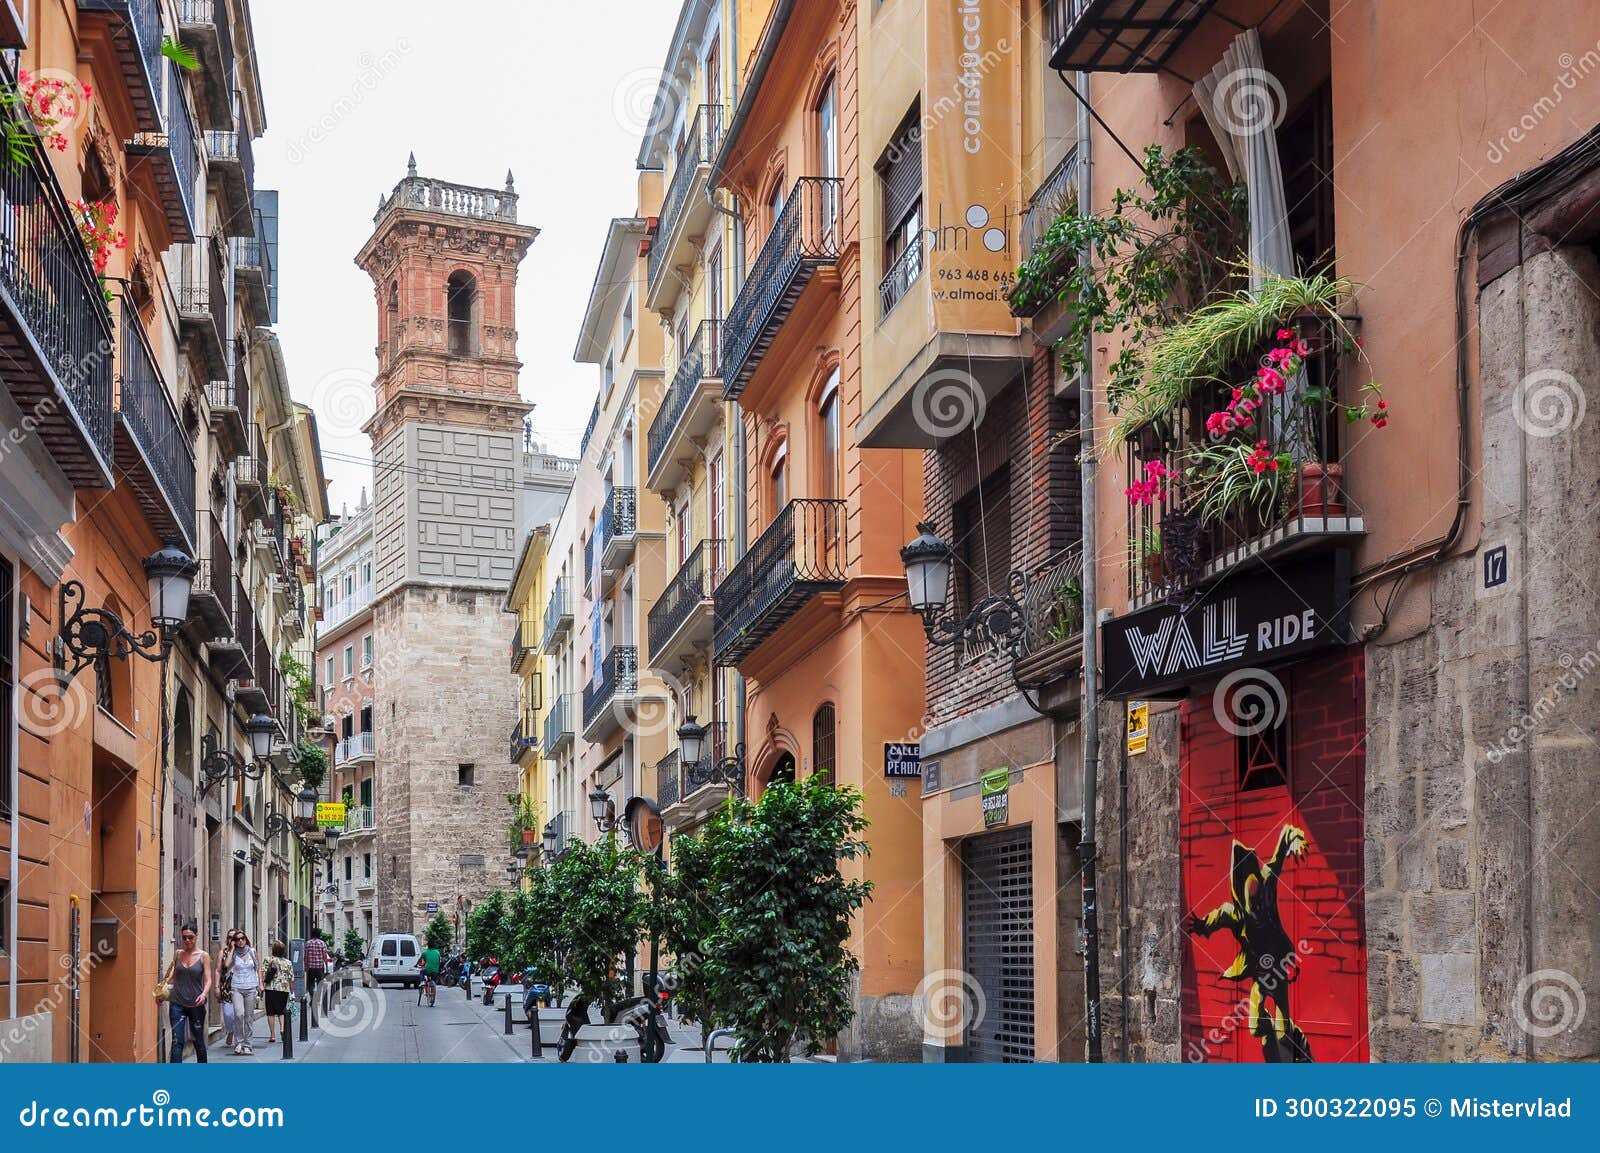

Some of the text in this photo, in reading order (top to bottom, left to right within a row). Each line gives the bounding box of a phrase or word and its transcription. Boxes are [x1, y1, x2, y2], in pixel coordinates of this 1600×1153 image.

[938, 269, 1015, 283] 963 468 665
[933, 288, 1008, 301] w.almodi.e
[1487, 551, 1504, 583] 17
[1125, 597, 1315, 680] WALL RIDE
[890, 745, 920, 756] CALLE
[887, 761, 922, 775] PERDIZ
